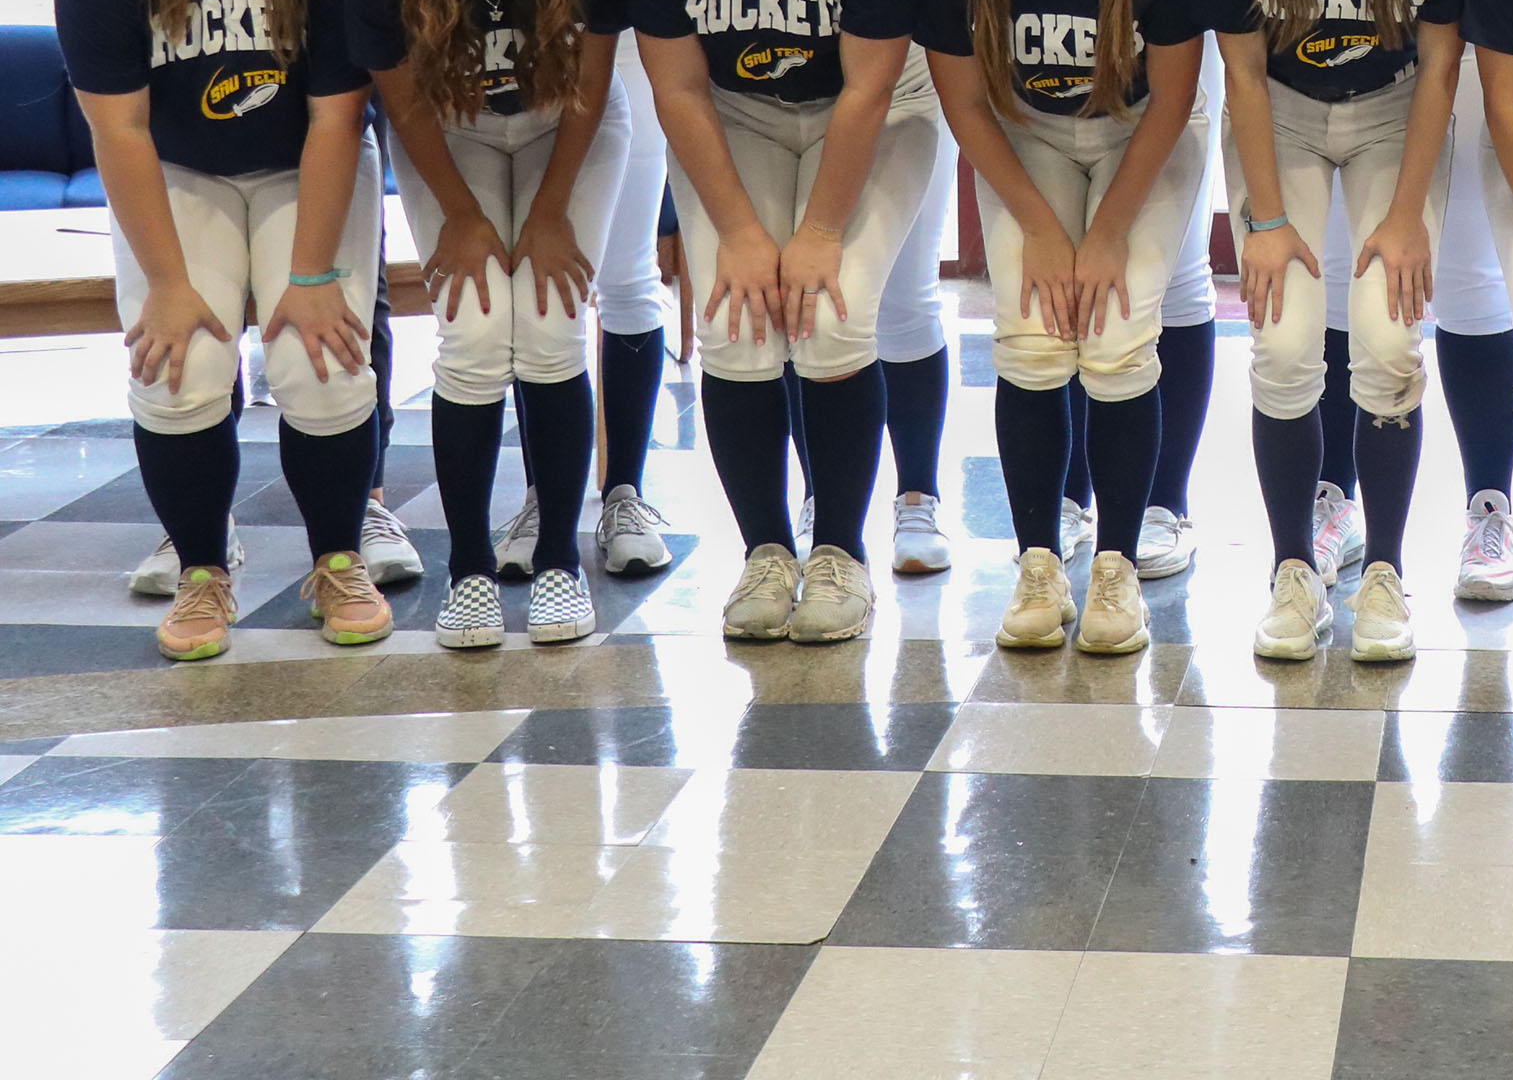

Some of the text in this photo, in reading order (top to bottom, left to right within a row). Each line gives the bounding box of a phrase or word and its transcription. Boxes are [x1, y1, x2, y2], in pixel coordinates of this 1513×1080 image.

[1306, 35, 1380, 53] SAU TECH
[744, 48, 772, 69] SAU
[210, 70, 287, 105] SAU TECH
